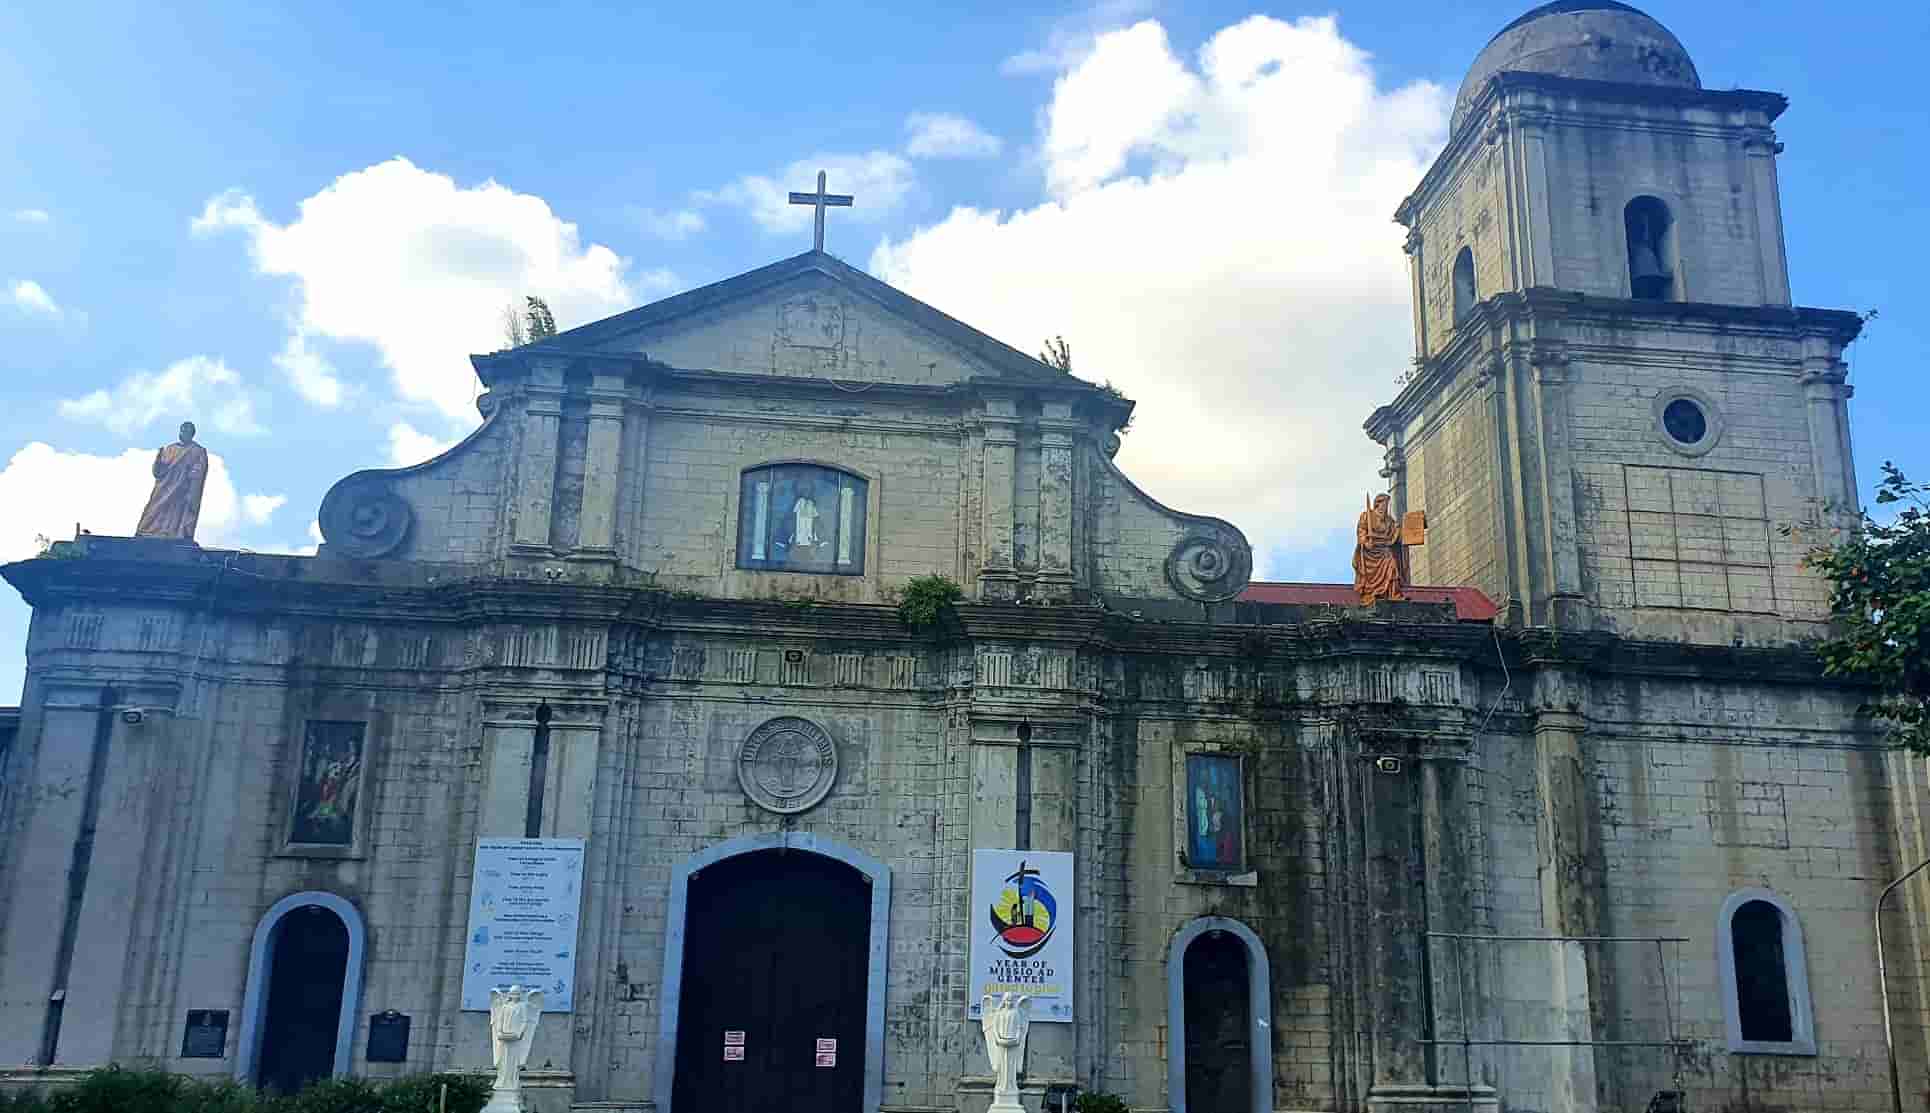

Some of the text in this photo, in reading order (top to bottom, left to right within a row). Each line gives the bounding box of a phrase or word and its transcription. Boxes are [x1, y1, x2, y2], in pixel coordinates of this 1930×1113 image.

[996, 960, 1048, 969] YEAR OF
[990, 967, 1054, 977] MISSIO AD
